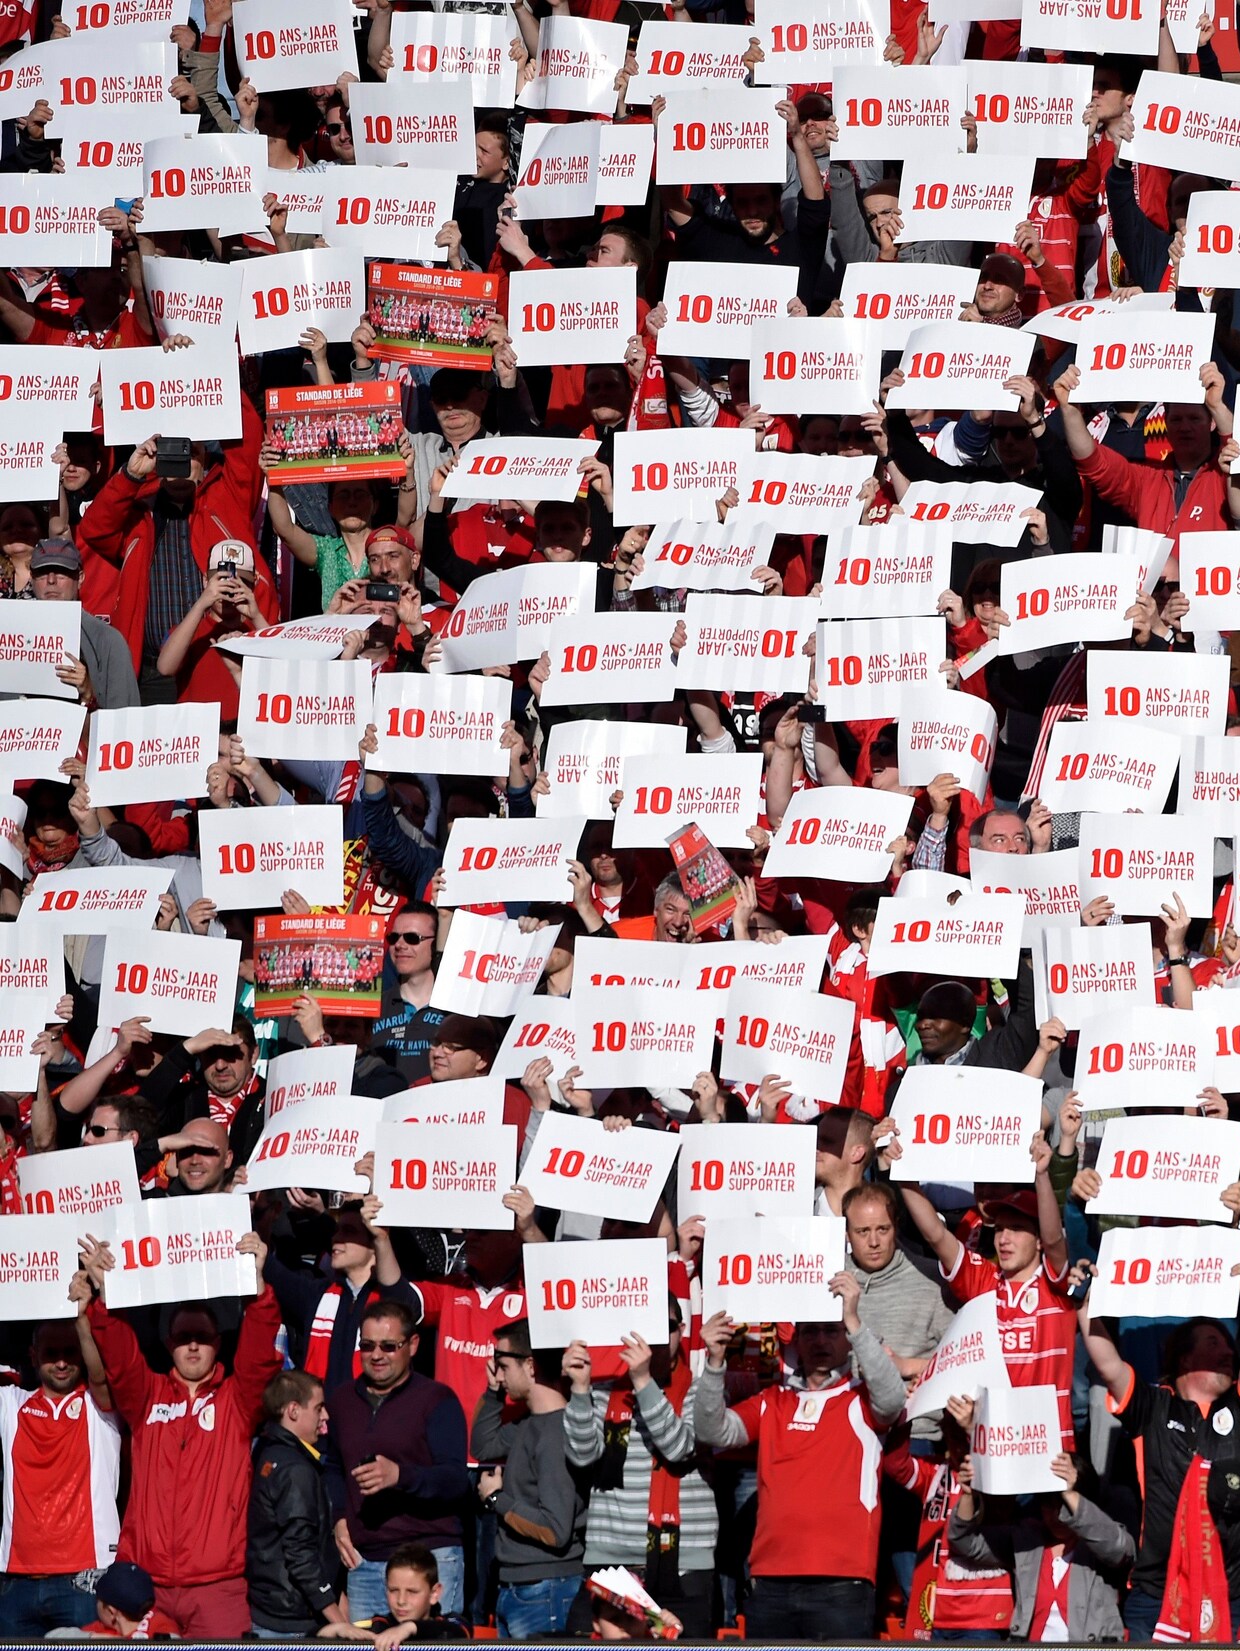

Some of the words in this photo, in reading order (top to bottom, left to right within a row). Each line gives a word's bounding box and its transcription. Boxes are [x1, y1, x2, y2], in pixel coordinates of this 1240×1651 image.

[61, 77, 96, 104] 10
[102, 90, 163, 104] SUPPORTER
[847, 99, 882, 127] 10
[888, 114, 949, 126] SUPPORTER
[674, 123, 705, 151] 10
[710, 137, 769, 150] SUPPORTER
[152, 169, 185, 197] 10
[191, 181, 251, 195] SUPPORTER
[398, 271, 432, 285] STANDARD
[434, 276, 442, 286] DE
[523, 303, 555, 332] 10
[560, 317, 618, 330] SUPPORTER
[909, 352, 945, 378] 10
[947, 367, 1008, 380] SUPPORTER
[120, 381, 155, 410] 10
[160, 394, 223, 408] SUPPORTER
[296, 391, 332, 401] STANDARD
[333, 390, 343, 398] DE
[699, 627, 760, 644] SUPPORTER
[761, 629, 797, 658] 10
[1105, 687, 1141, 717] 10
[1146, 704, 1209, 718] SUPPORTER
[100, 741, 134, 771] 10
[138, 751, 199, 767] SUPPORTER
[219, 843, 255, 874] 10
[260, 858, 324, 872] SUPPORTER
[1091, 848, 1123, 879] 10
[1128, 866, 1194, 880] SUPPORTER
[280, 919, 313, 930] STANDARD
[315, 919, 324, 929] DE
[391, 1159, 427, 1190] 10
[691, 1160, 724, 1191] 10
[432, 1177, 496, 1192] SUPPORTER
[729, 1178, 794, 1192] SUPPORTER
[719, 1254, 752, 1286] 10
[758, 1271, 823, 1284] SUPPORTER
[543, 1279, 576, 1311] 10
[582, 1294, 648, 1309] SUPPORTER
